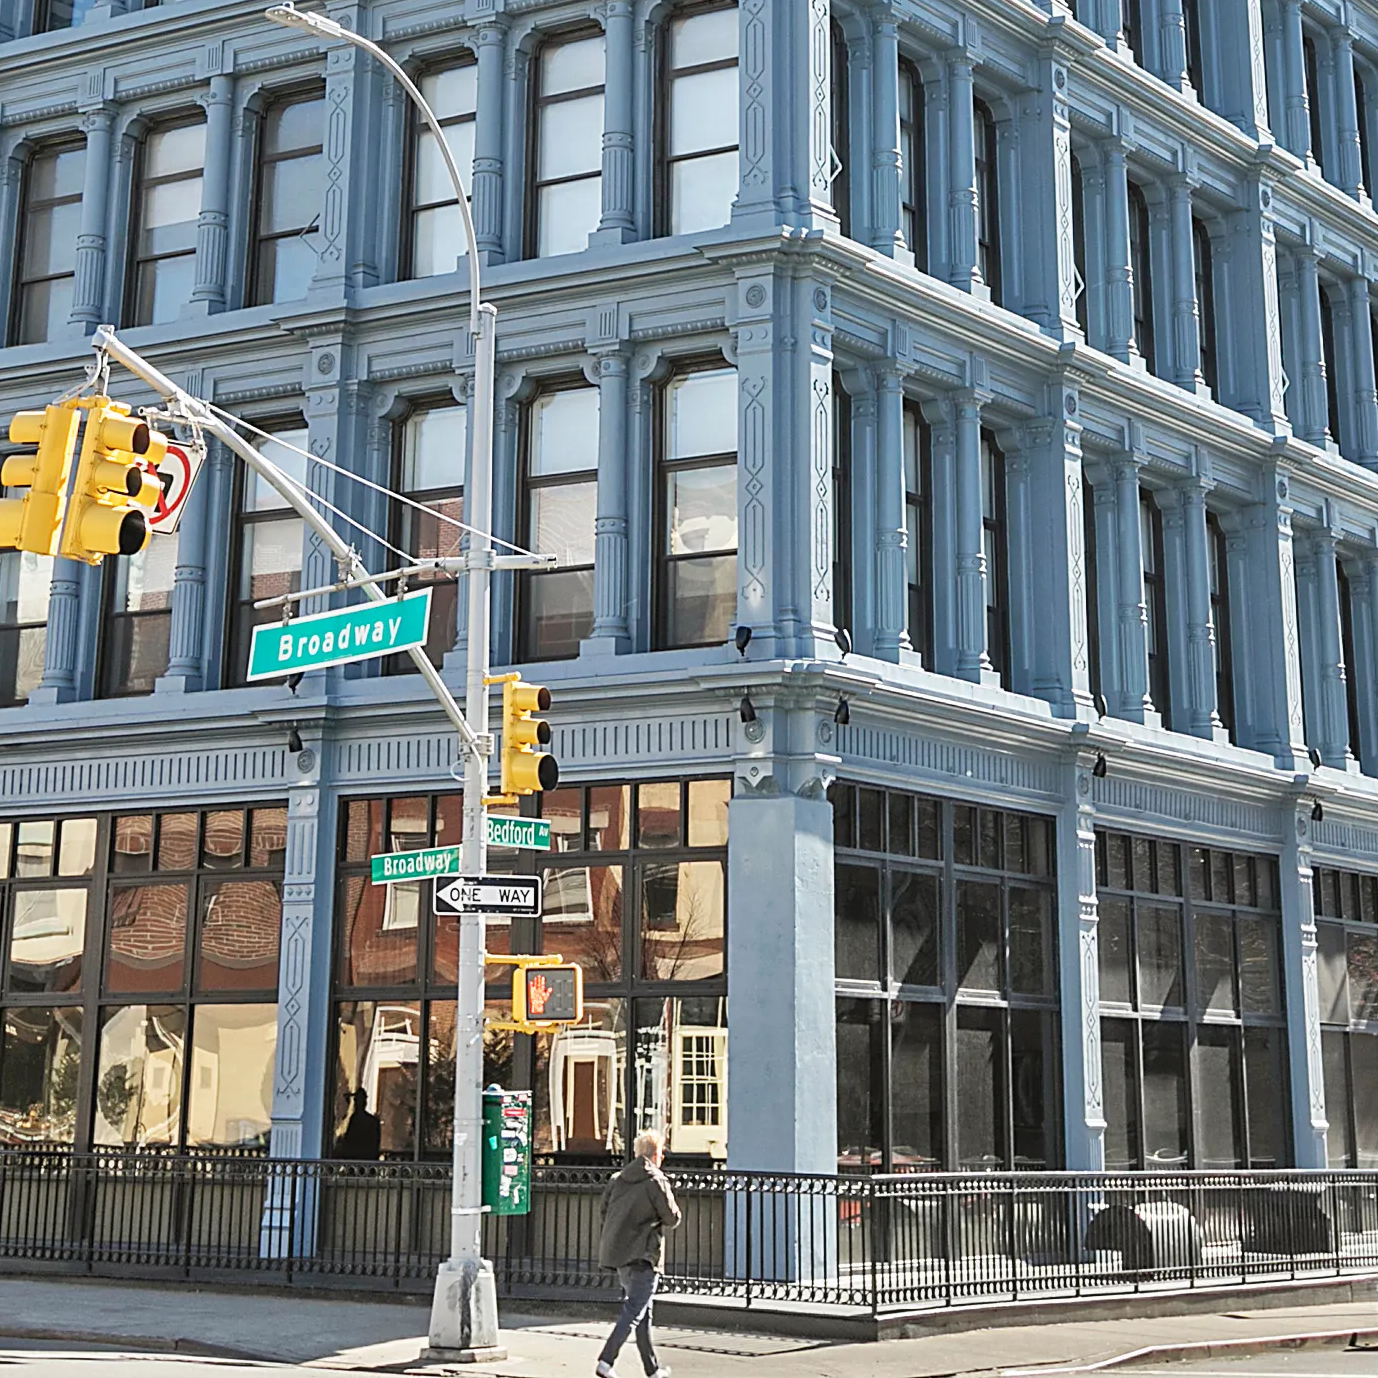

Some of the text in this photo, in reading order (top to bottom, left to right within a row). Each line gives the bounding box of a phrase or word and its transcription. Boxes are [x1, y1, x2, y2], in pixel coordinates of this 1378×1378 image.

[278, 616, 402, 661] Broadway
[487, 819, 535, 845] Bedford
[383, 851, 452, 876] Broadway
[449, 887, 530, 903] ONE WAY
